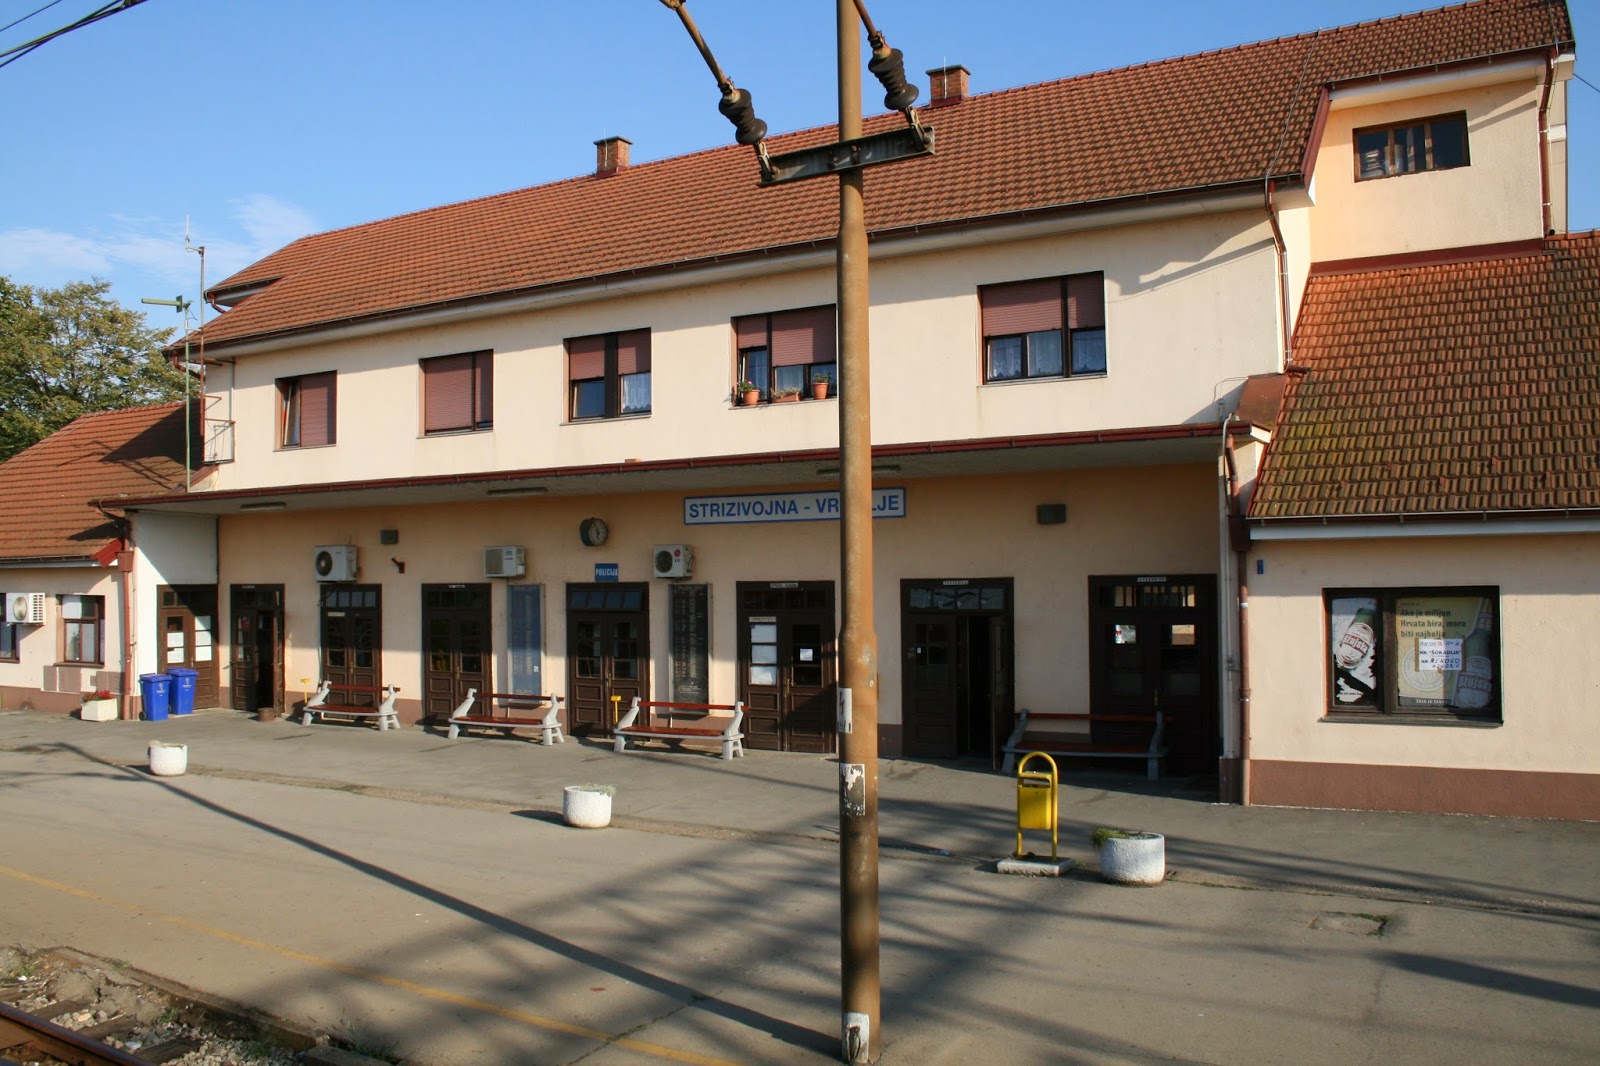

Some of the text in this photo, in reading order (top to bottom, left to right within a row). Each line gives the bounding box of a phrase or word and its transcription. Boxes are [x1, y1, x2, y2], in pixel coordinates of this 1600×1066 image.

[690, 499, 798, 518] STRIZIVOJNA
[815, 495, 899, 513] VRJE
[596, 568, 618, 576] POLICIJA
[1424, 608, 1451, 618] milijun
[1400, 619, 1425, 627] Hrvata
